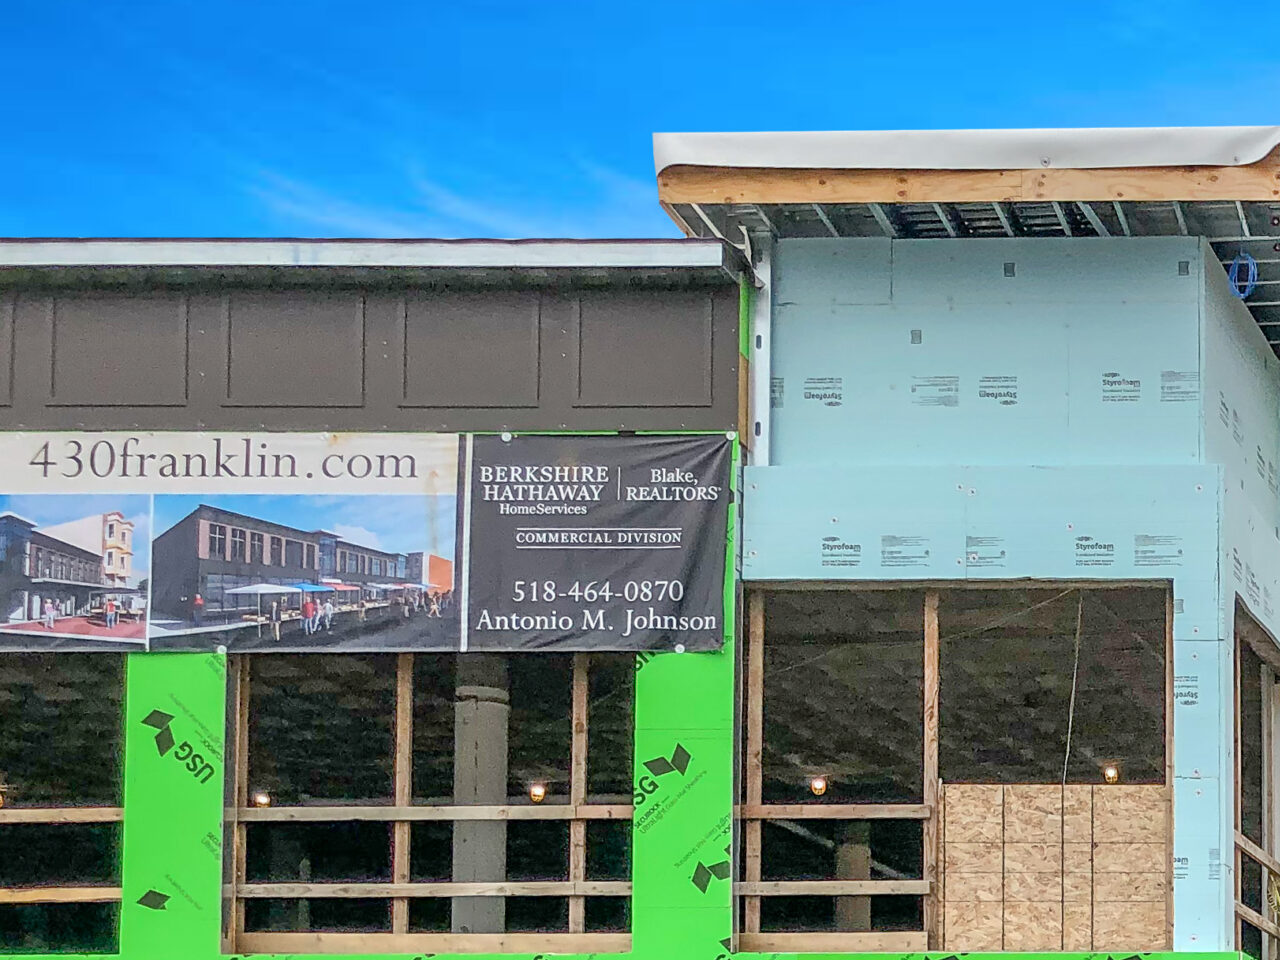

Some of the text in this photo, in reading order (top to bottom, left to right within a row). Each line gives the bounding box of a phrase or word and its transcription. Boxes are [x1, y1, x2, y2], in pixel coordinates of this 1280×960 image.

[29, 438, 418, 479] 430franklin.com
[480, 466, 609, 482] BERKSHIRE
[651, 468, 698, 485] Blake,
[484, 485, 604, 501] HATHAWAY
[500, 503, 588, 515] HomeServices
[516, 532, 682, 544] COMMERCIAL DIVISION
[513, 580, 684, 602] 518-464-0870
[476, 607, 717, 637] Antonio M. Johnson
[174, 741, 215, 784] USG
[633, 776, 660, 811] SG
